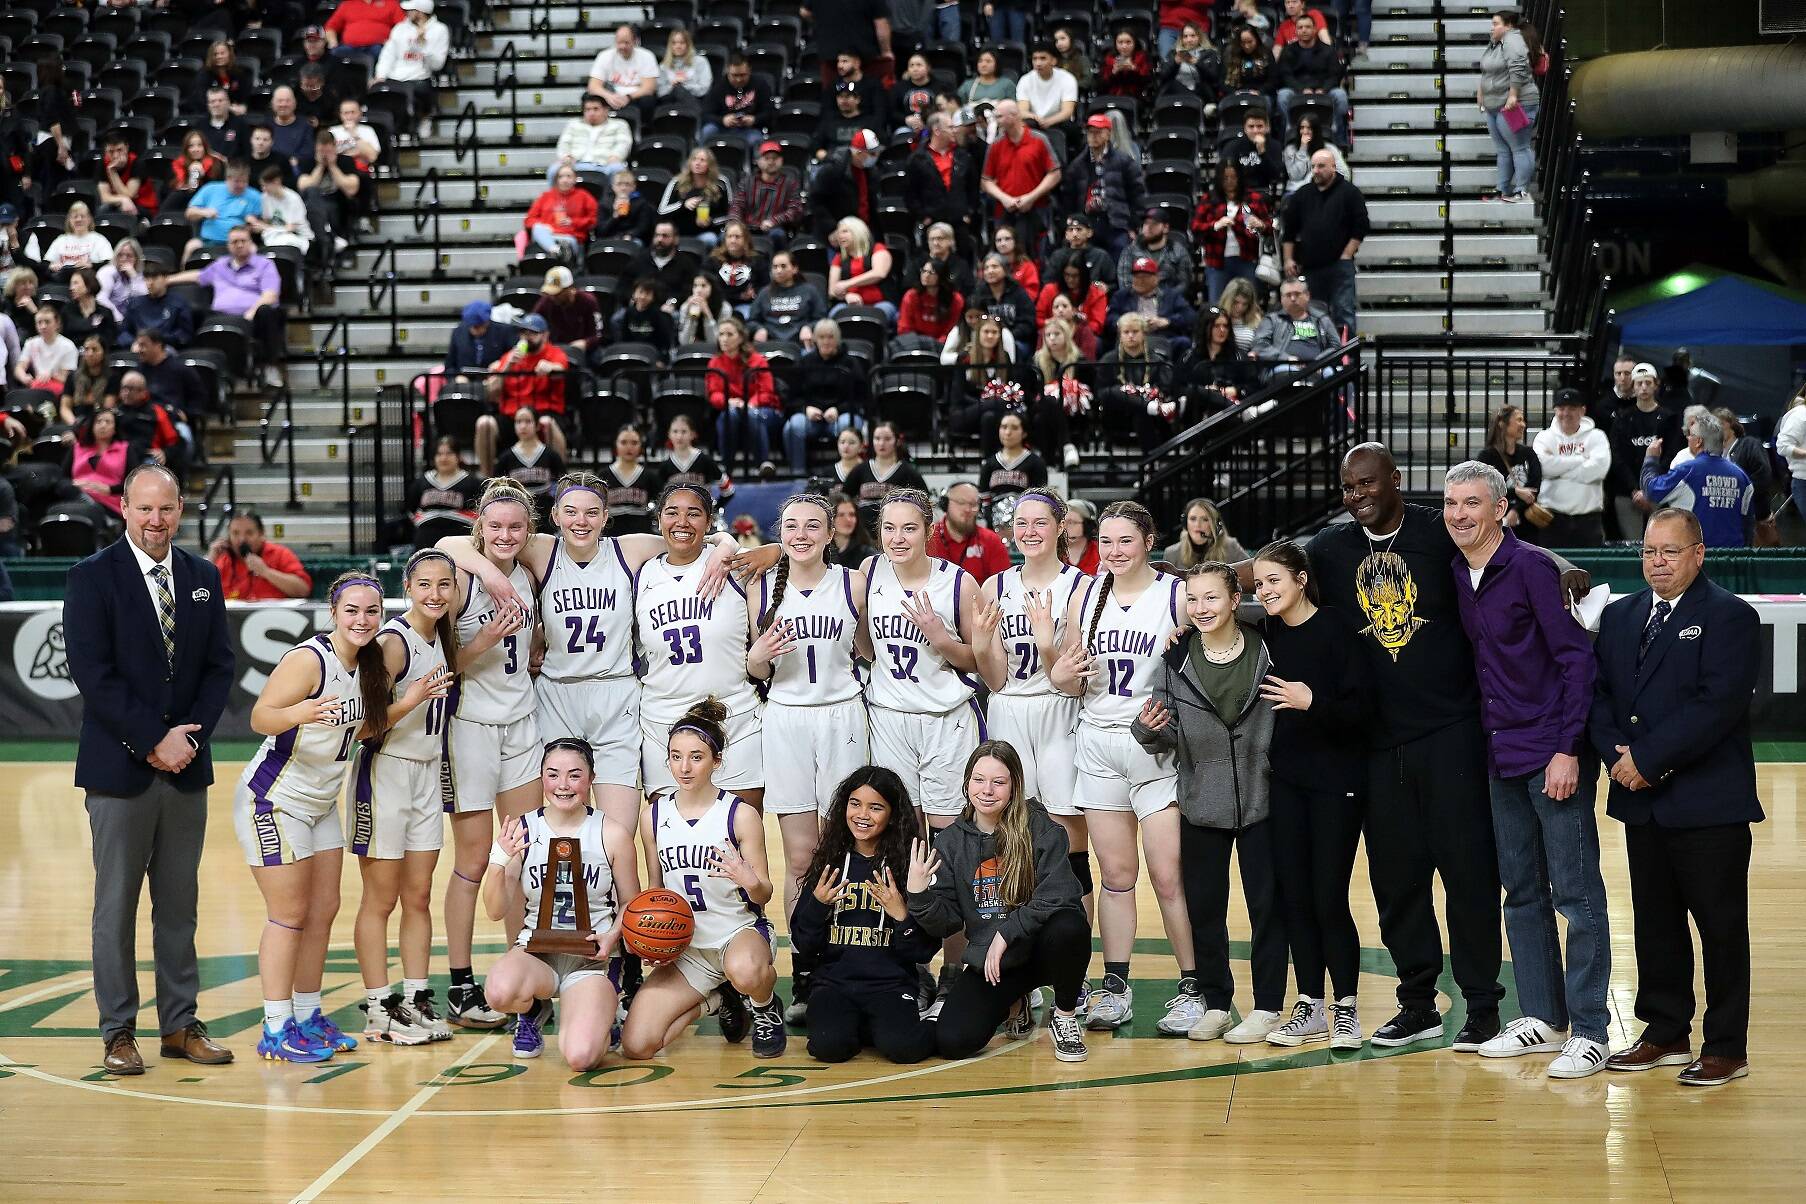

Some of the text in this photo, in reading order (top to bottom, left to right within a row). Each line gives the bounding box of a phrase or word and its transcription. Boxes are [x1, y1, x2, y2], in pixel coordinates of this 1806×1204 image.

[1705, 475, 1738, 489] CROWD
[1709, 497, 1735, 509] STAFF
[553, 587, 617, 614] SEQUIM
[649, 595, 714, 630] SEQUIM
[565, 615, 606, 654] 24
[663, 625, 703, 666] 33
[872, 615, 931, 647] SEQUI
[503, 634, 518, 675] 3
[806, 644, 817, 683] 1
[887, 643, 920, 683] 32
[1107, 658, 1134, 698] 12
[440, 761, 454, 803] WOLVES
[254, 813, 281, 856] WOLVES
[354, 801, 373, 845] WOLVES
[554, 891, 576, 923] 2
[683, 875, 708, 912] 5
[828, 925, 894, 947] NIVERSIT
